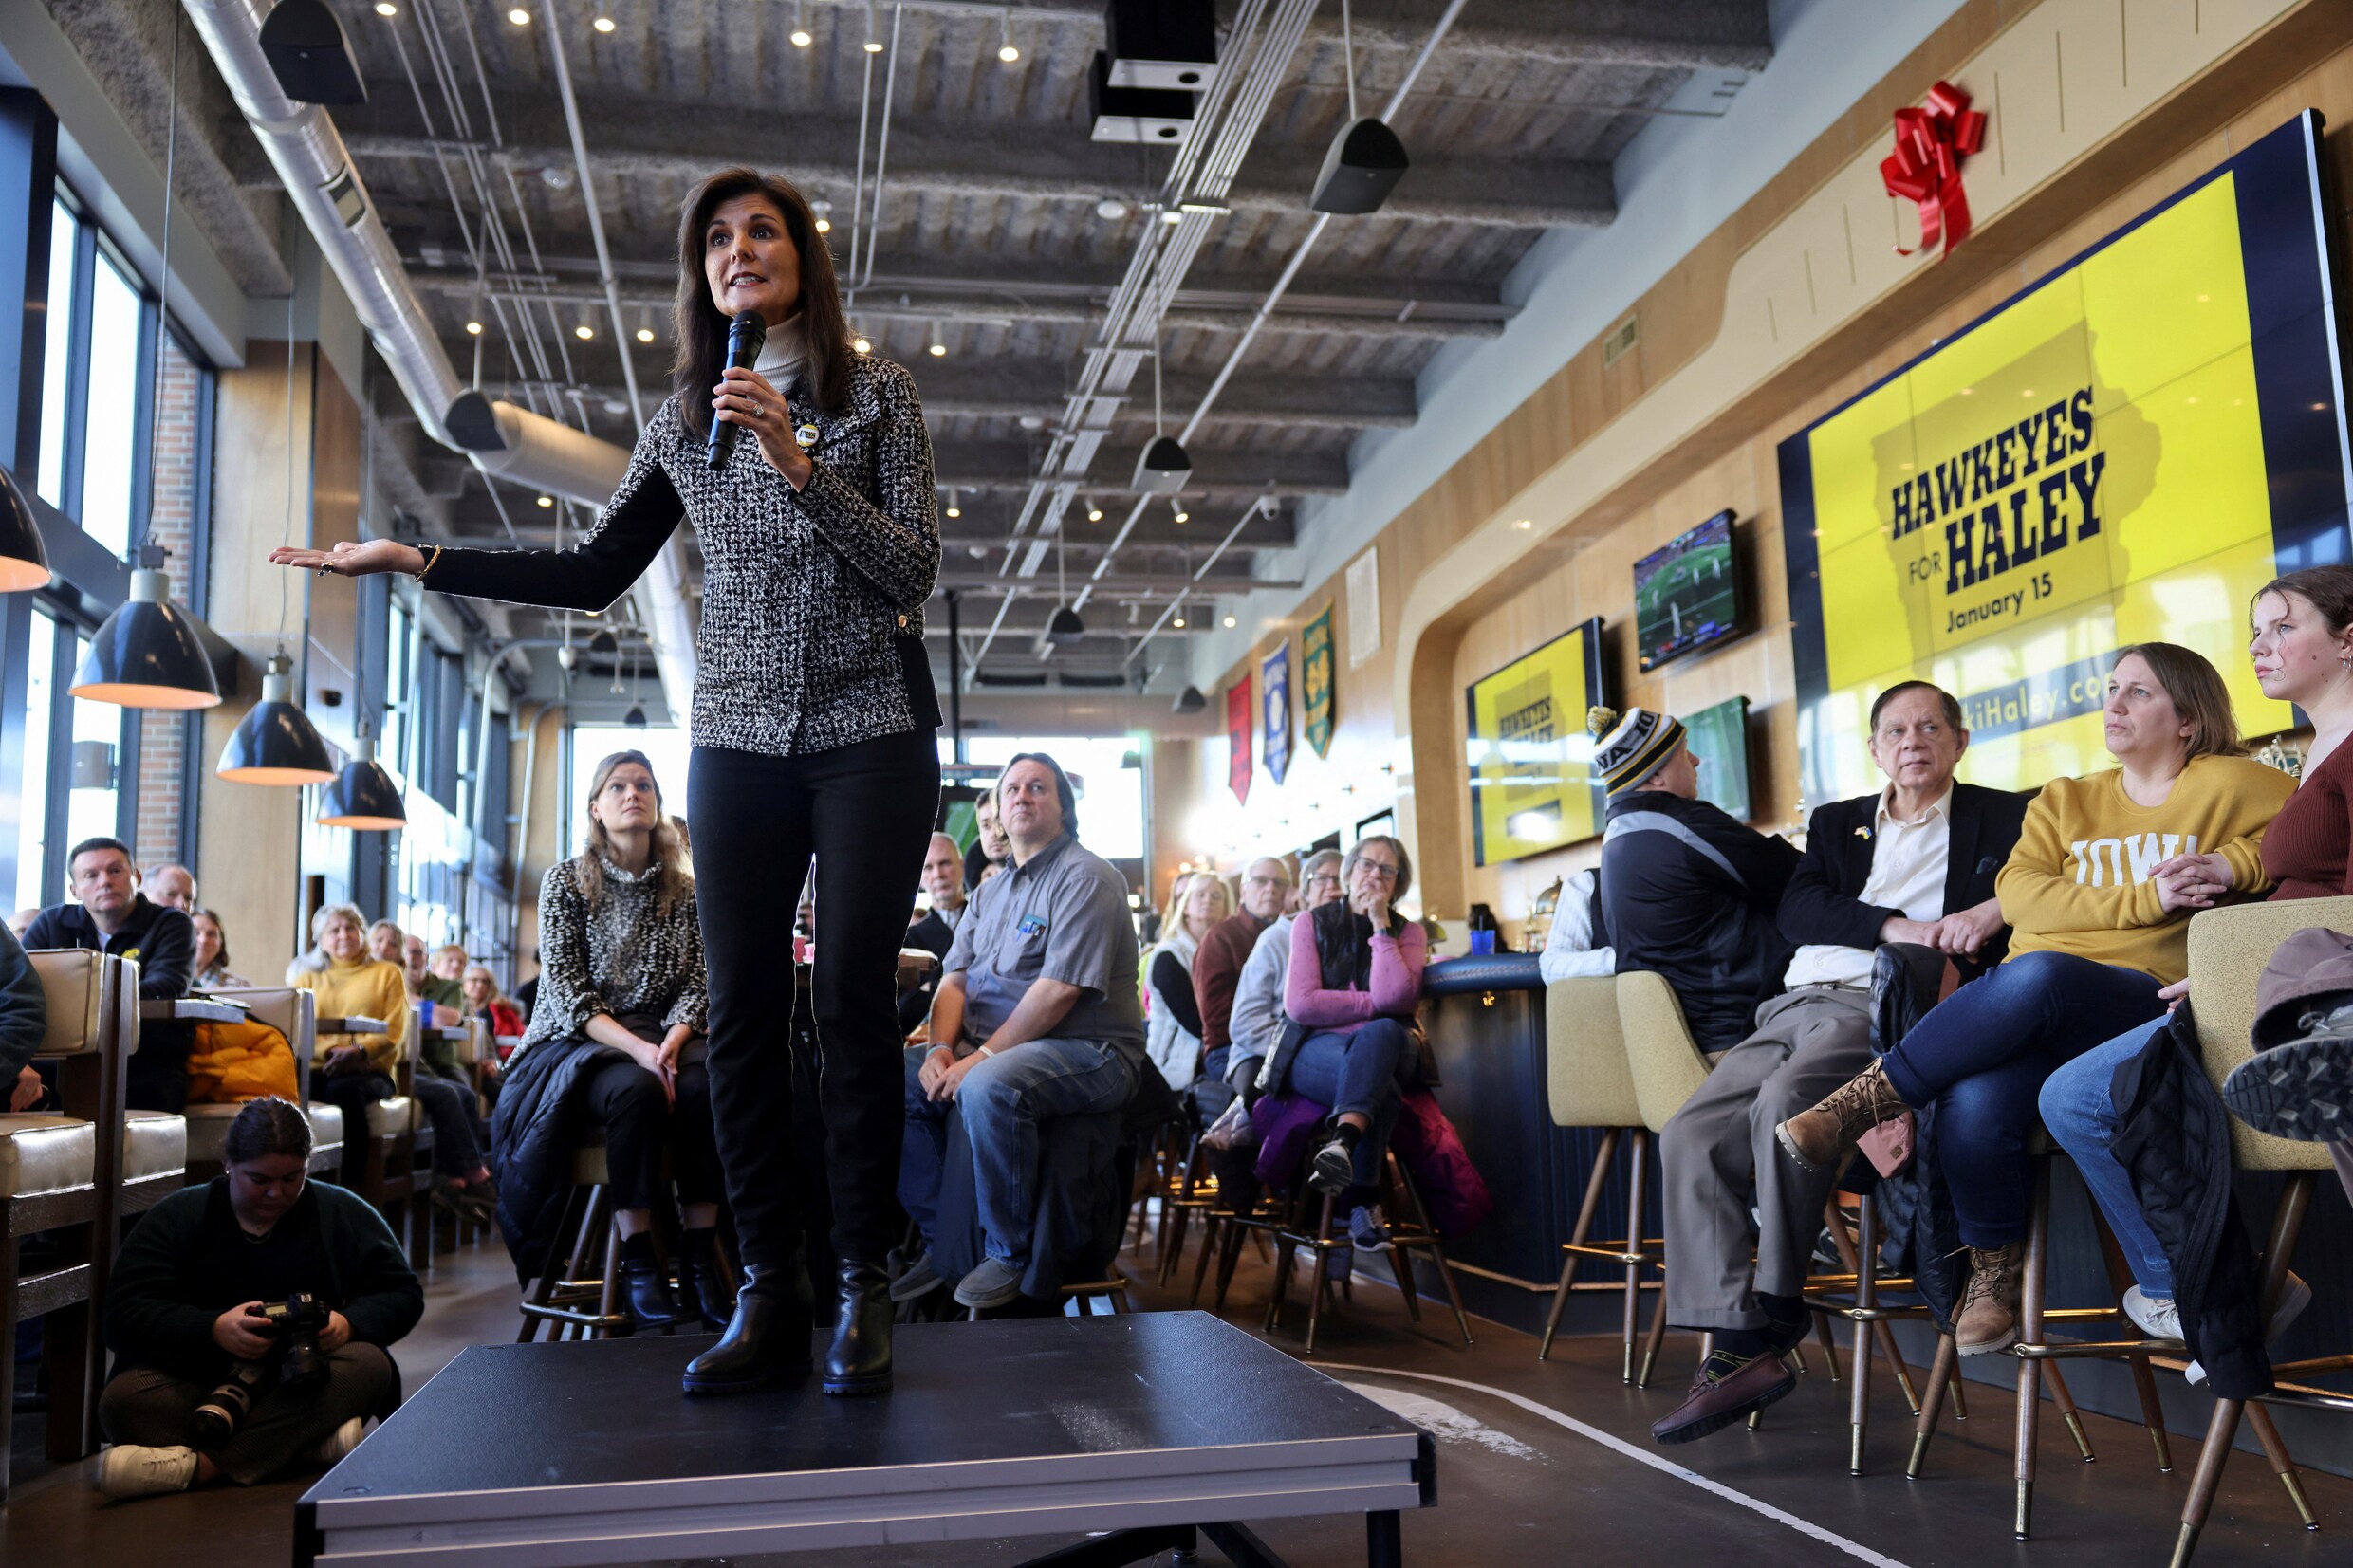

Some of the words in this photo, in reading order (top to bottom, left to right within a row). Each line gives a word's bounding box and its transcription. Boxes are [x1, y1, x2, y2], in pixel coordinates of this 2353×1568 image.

[1892, 384, 2093, 541] HAWKEYES
[1909, 551, 1944, 585] FOR
[1946, 450, 2106, 596] HALEY
[1947, 589, 2025, 633] January
[2031, 572, 2053, 600] 15
